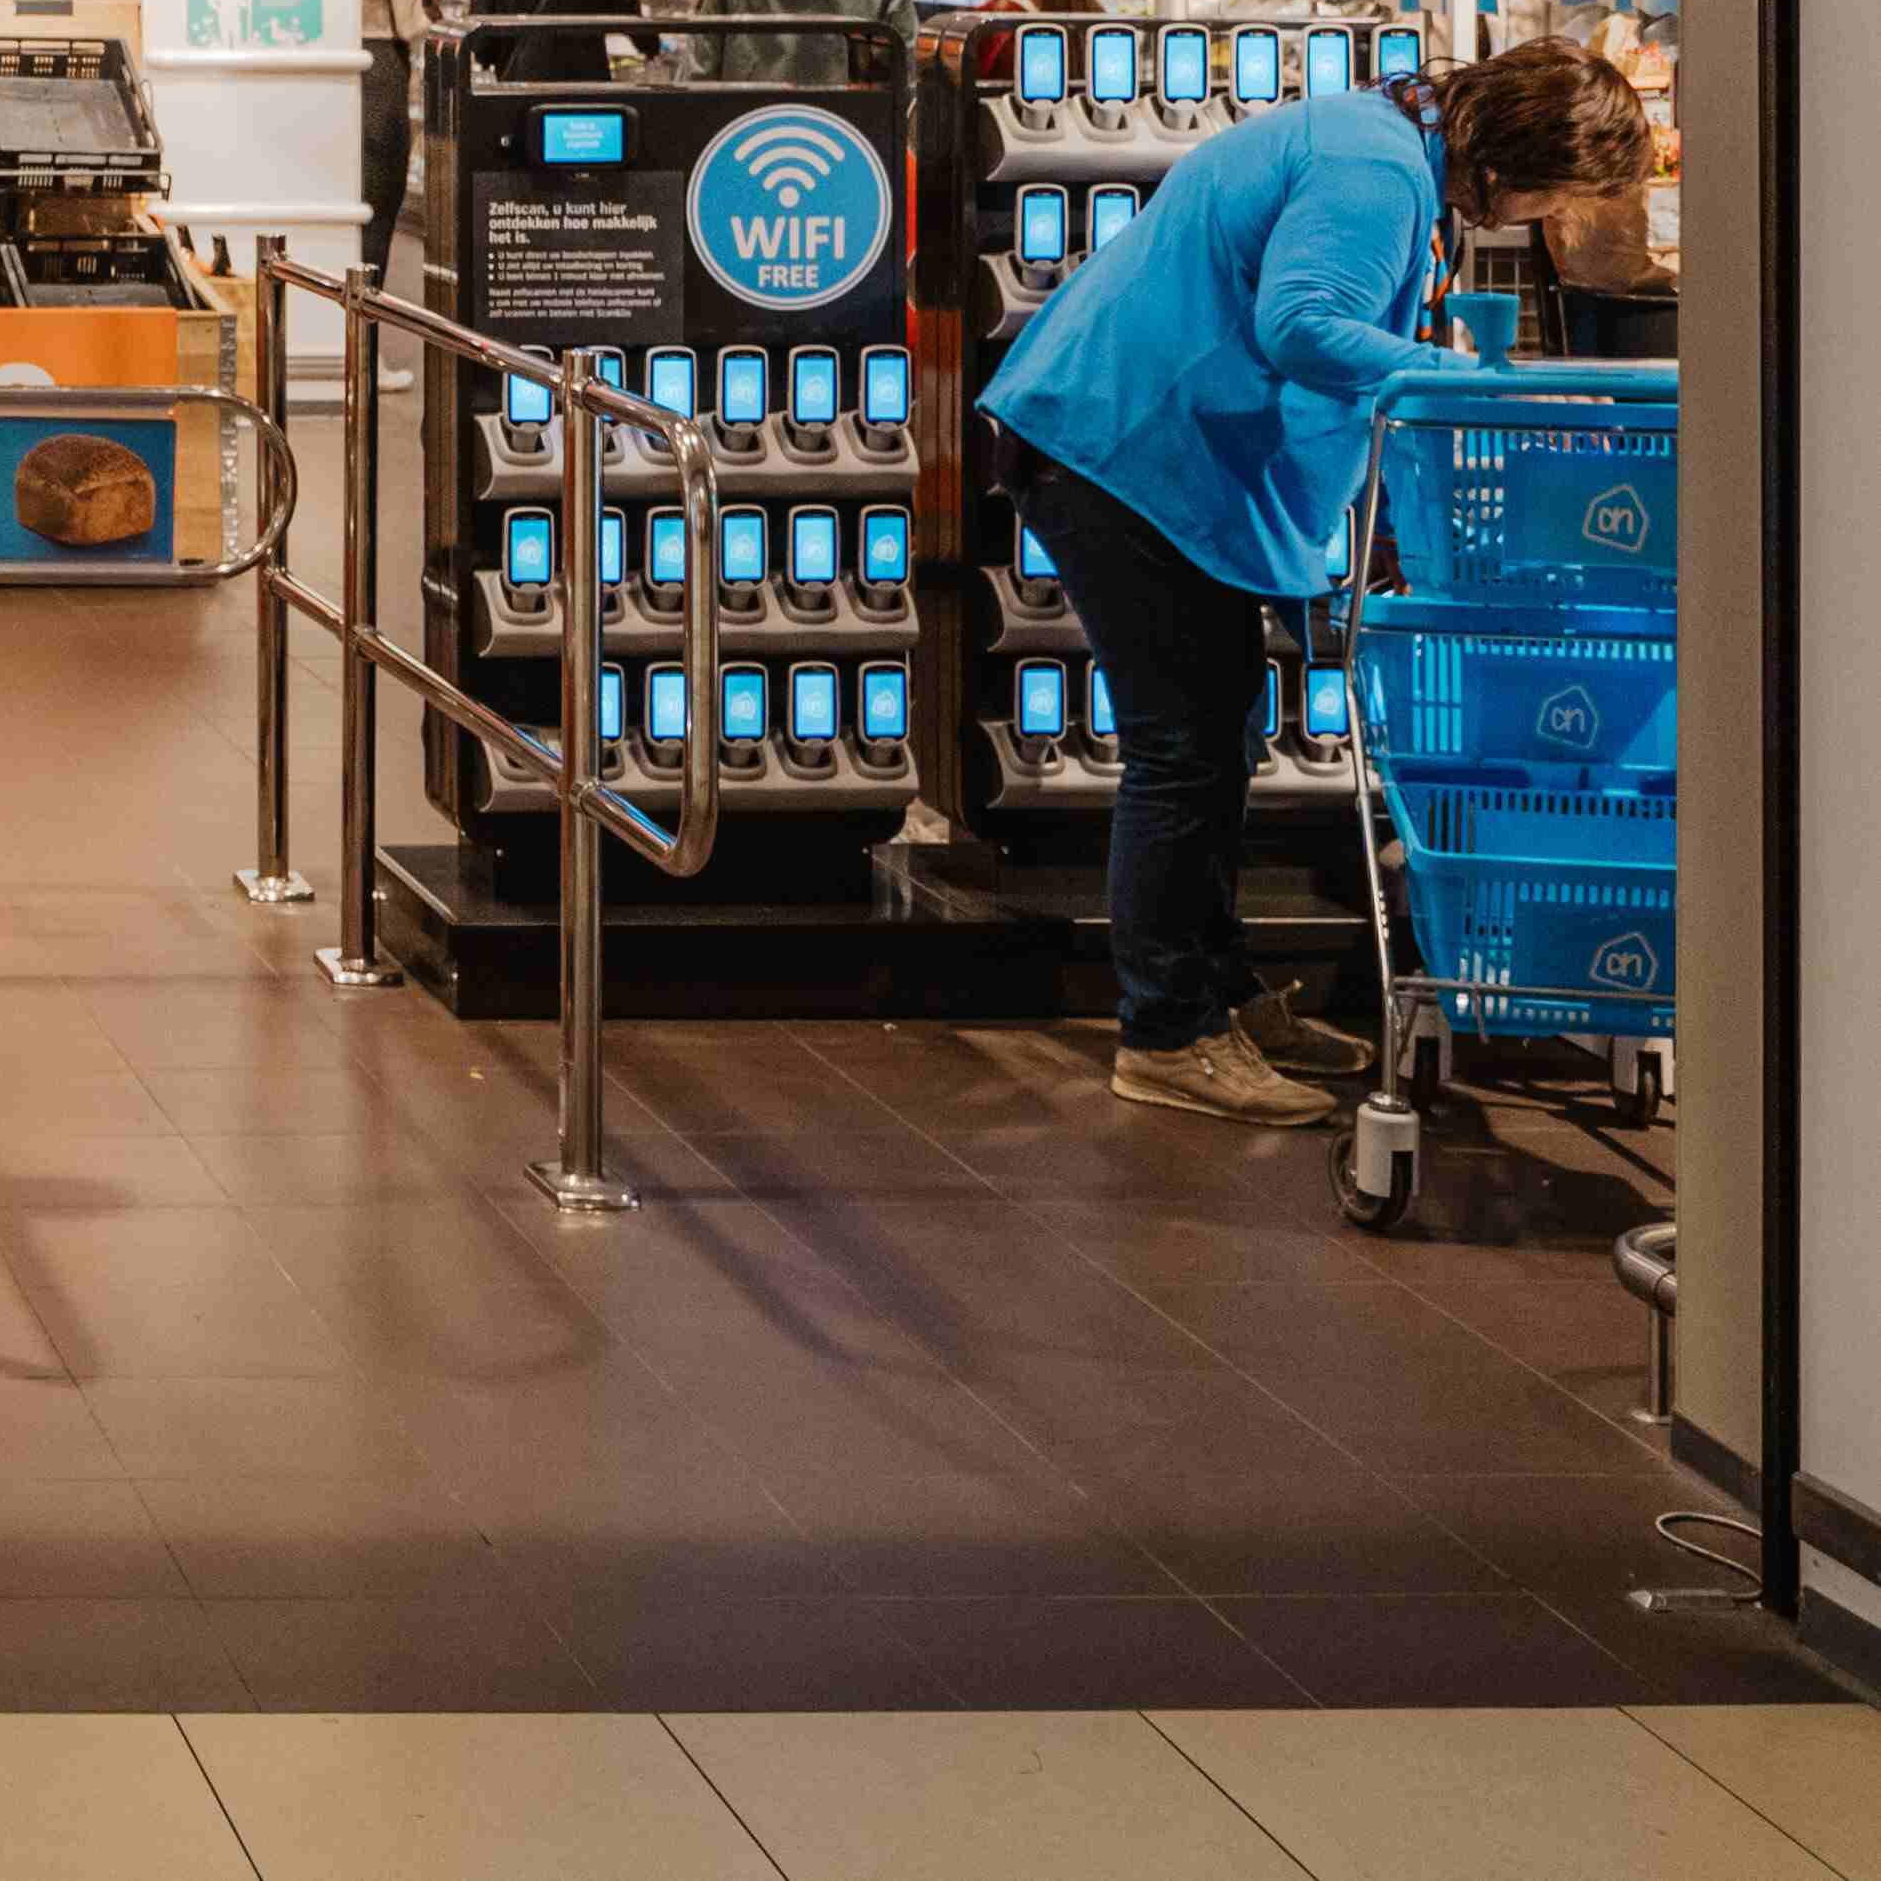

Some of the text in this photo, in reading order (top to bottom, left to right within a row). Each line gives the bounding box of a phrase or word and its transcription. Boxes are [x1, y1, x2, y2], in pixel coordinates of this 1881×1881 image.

[489, 201, 627, 216] Zelfscan, u kunt hier
[489, 214, 657, 232] ontdekken hoe makkelijk
[489, 230, 531, 244] het is.
[730, 215, 846, 260] WIFI
[757, 264, 820, 289] FREE
